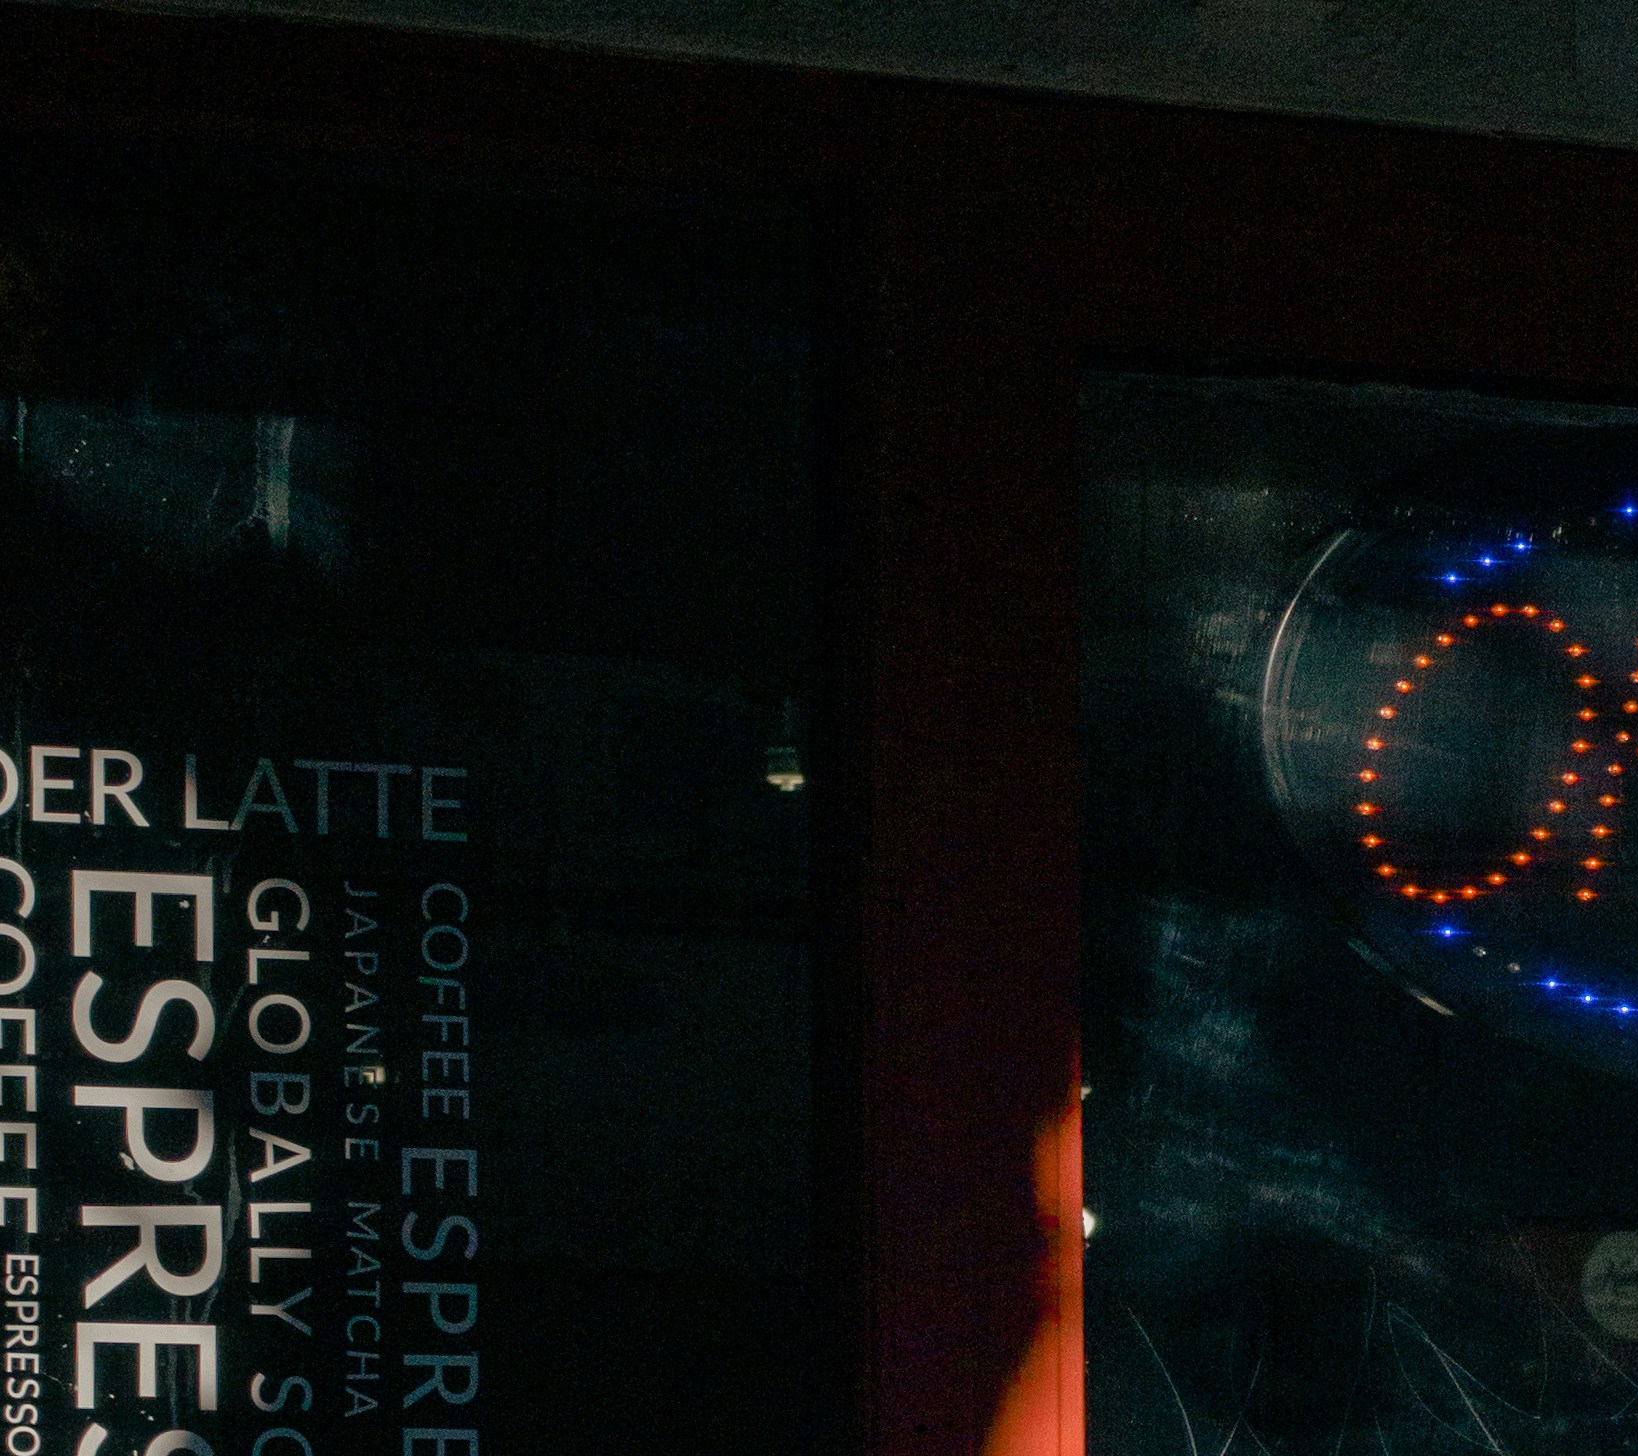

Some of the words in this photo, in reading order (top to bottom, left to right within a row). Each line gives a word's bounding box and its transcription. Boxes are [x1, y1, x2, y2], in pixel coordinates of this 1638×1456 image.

[185, 753, 469, 842] LATTE
[247, 877, 314, 1337] GLOBALLY
[344, 880, 381, 1160] JAPANESE
[418, 882, 470, 1120] COFFEE
[345, 1201, 382, 1417] MATCHA
